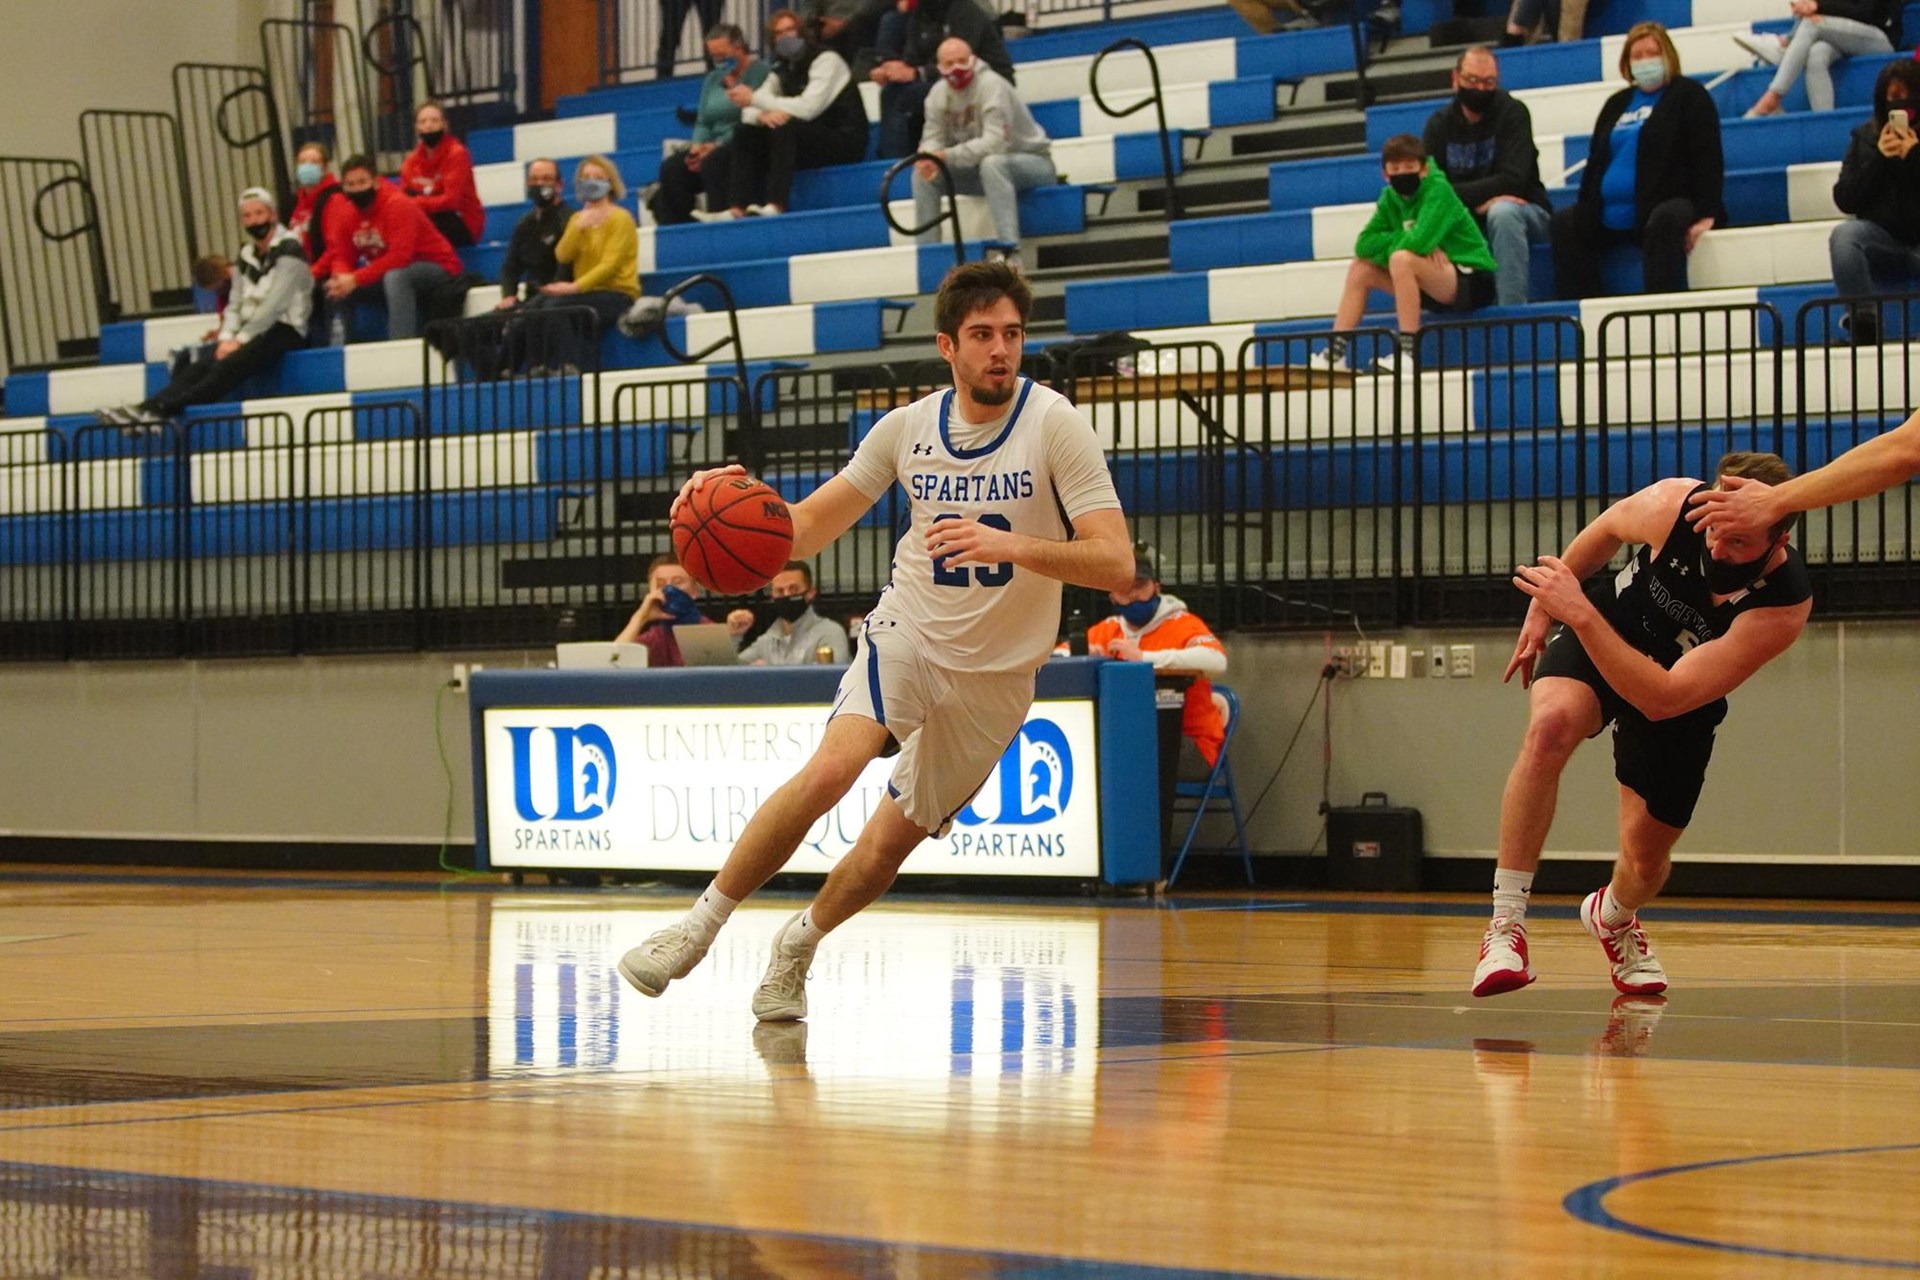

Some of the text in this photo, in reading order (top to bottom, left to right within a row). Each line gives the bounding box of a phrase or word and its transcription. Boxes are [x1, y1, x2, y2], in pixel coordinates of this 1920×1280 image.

[912, 470, 1033, 502] SPARTANS
[644, 722, 829, 762] UNIVERSI
[514, 828, 612, 851] SPARTANS
[950, 833, 1066, 857] SPARTANS
